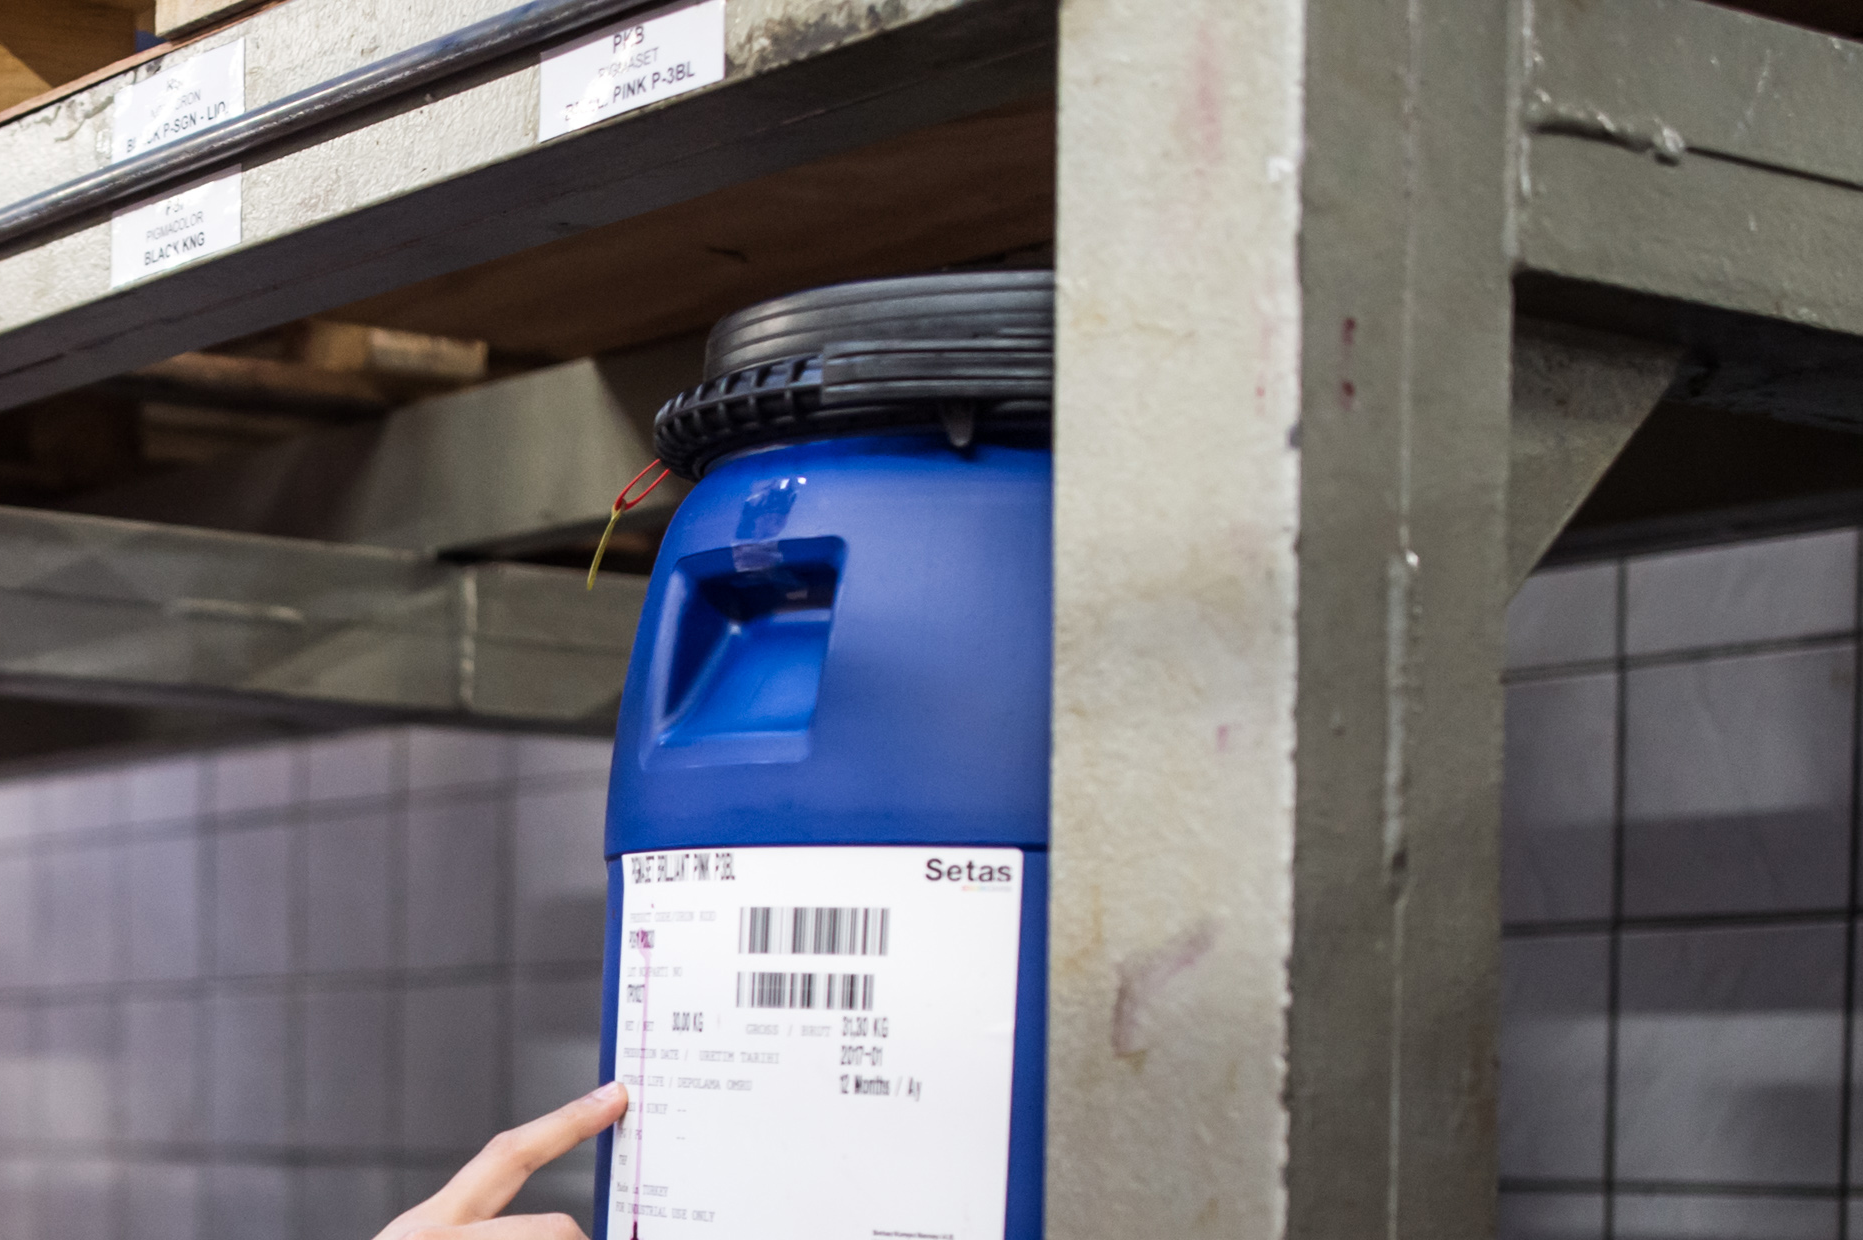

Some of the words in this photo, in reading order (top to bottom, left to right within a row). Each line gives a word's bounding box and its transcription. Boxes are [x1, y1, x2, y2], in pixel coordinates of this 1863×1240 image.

[612, 76, 646, 104] PINK
[651, 61, 695, 90] P-3BL
[144, 240, 180, 265] BLACK
[182, 231, 205, 253] KNG
[926, 858, 1012, 882] Setas
[874, 1017, 889, 1038] KG
[855, 1074, 890, 1096] Months
